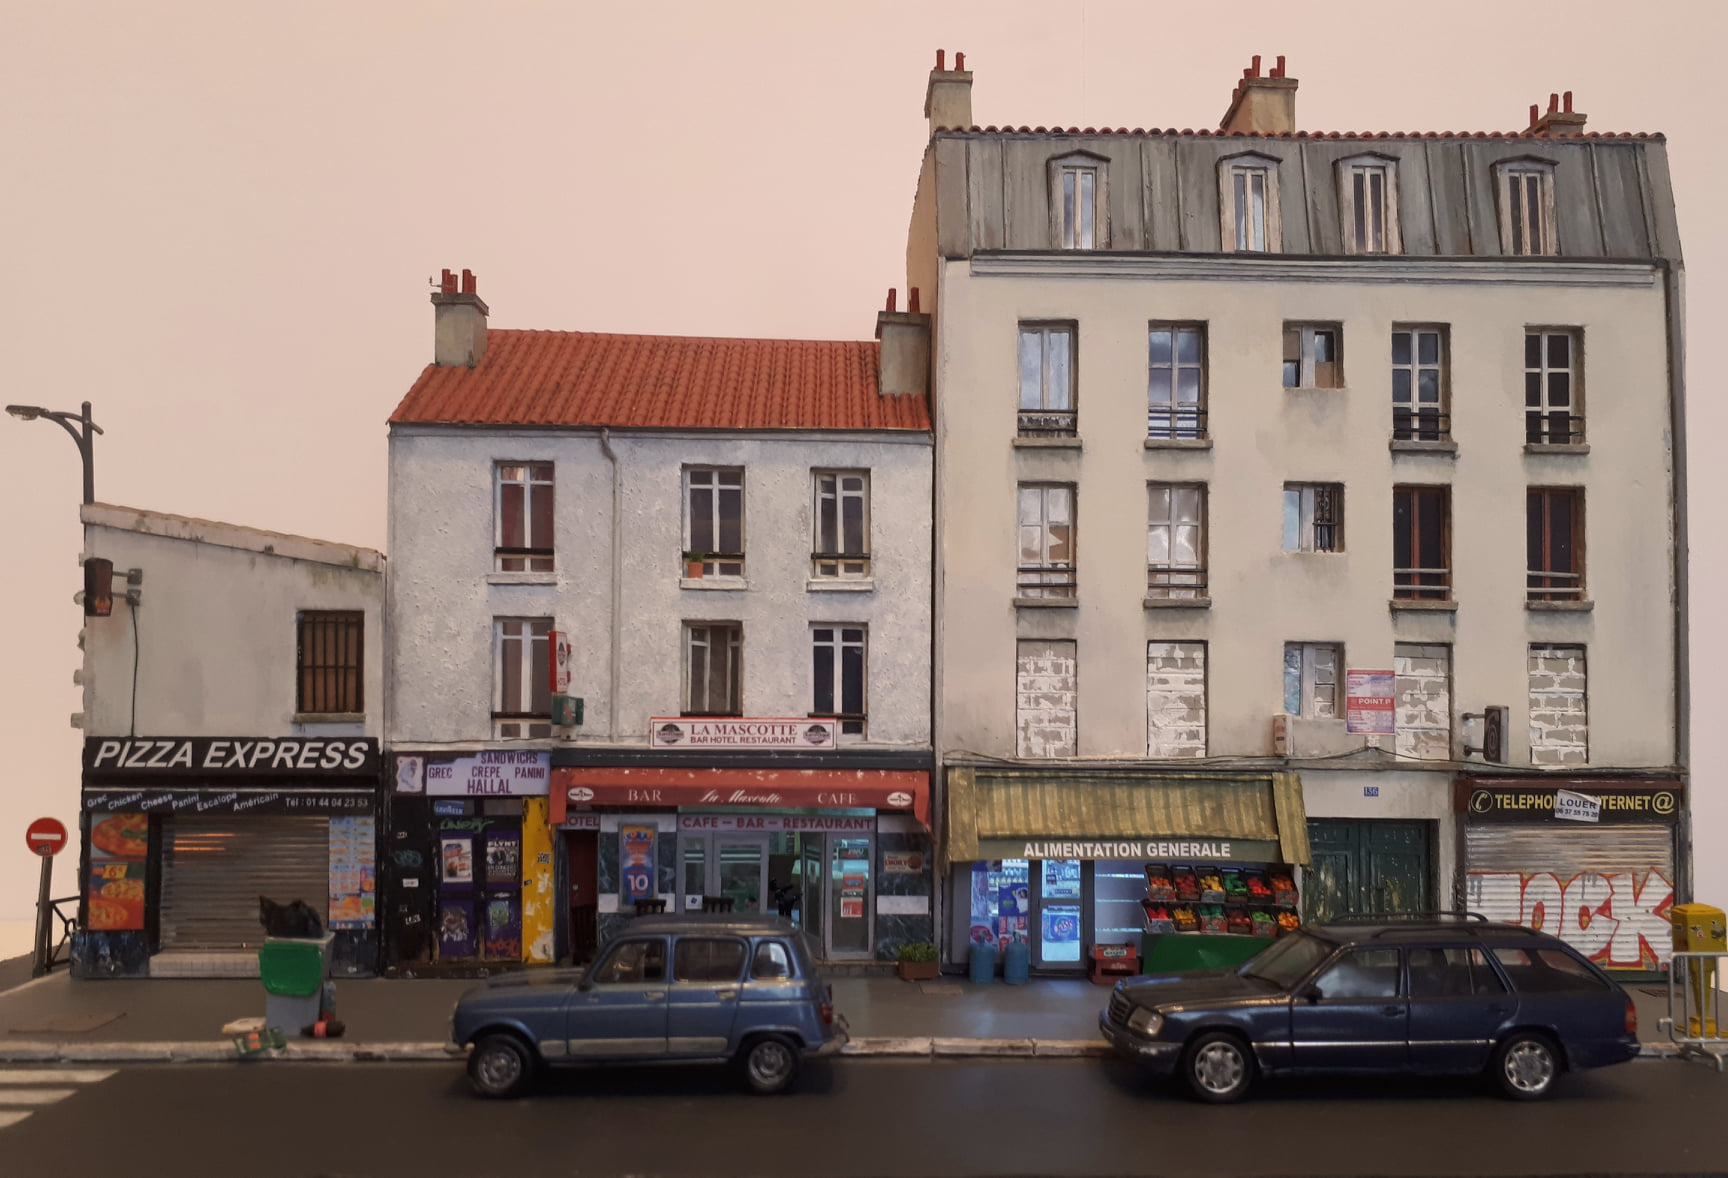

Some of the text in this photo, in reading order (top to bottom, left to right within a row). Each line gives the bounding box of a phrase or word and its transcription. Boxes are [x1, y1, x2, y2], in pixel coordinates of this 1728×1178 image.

[690, 724, 709, 736] LA
[714, 724, 798, 736] MASCOTTE
[690, 736, 796, 745] BAR HOTEL RESTAURANT
[93, 741, 369, 769] PIZZA EXPRESS
[481, 751, 538, 765] SANDWICHS
[428, 766, 545, 779] GREC CREPE PANINI
[466, 778, 513, 794] HALLAL
[87, 794, 108, 808] Grec
[107, 792, 143, 810] Chicken
[140, 793, 173, 810] Cheese
[171, 793, 200, 810] Panini
[196, 792, 237, 812] Escalope
[306, 798, 316, 807] 01
[319, 797, 329, 807] 44
[628, 789, 662, 802] BAR
[1560, 798, 1597, 809] LOUER
[682, 817, 718, 829] CAFE
[736, 817, 764, 829] BAR
[783, 817, 873, 830] RESTAURANT
[1023, 842, 1231, 858] ALIMENTATION GENERALE
[627, 874, 649, 891] 10
